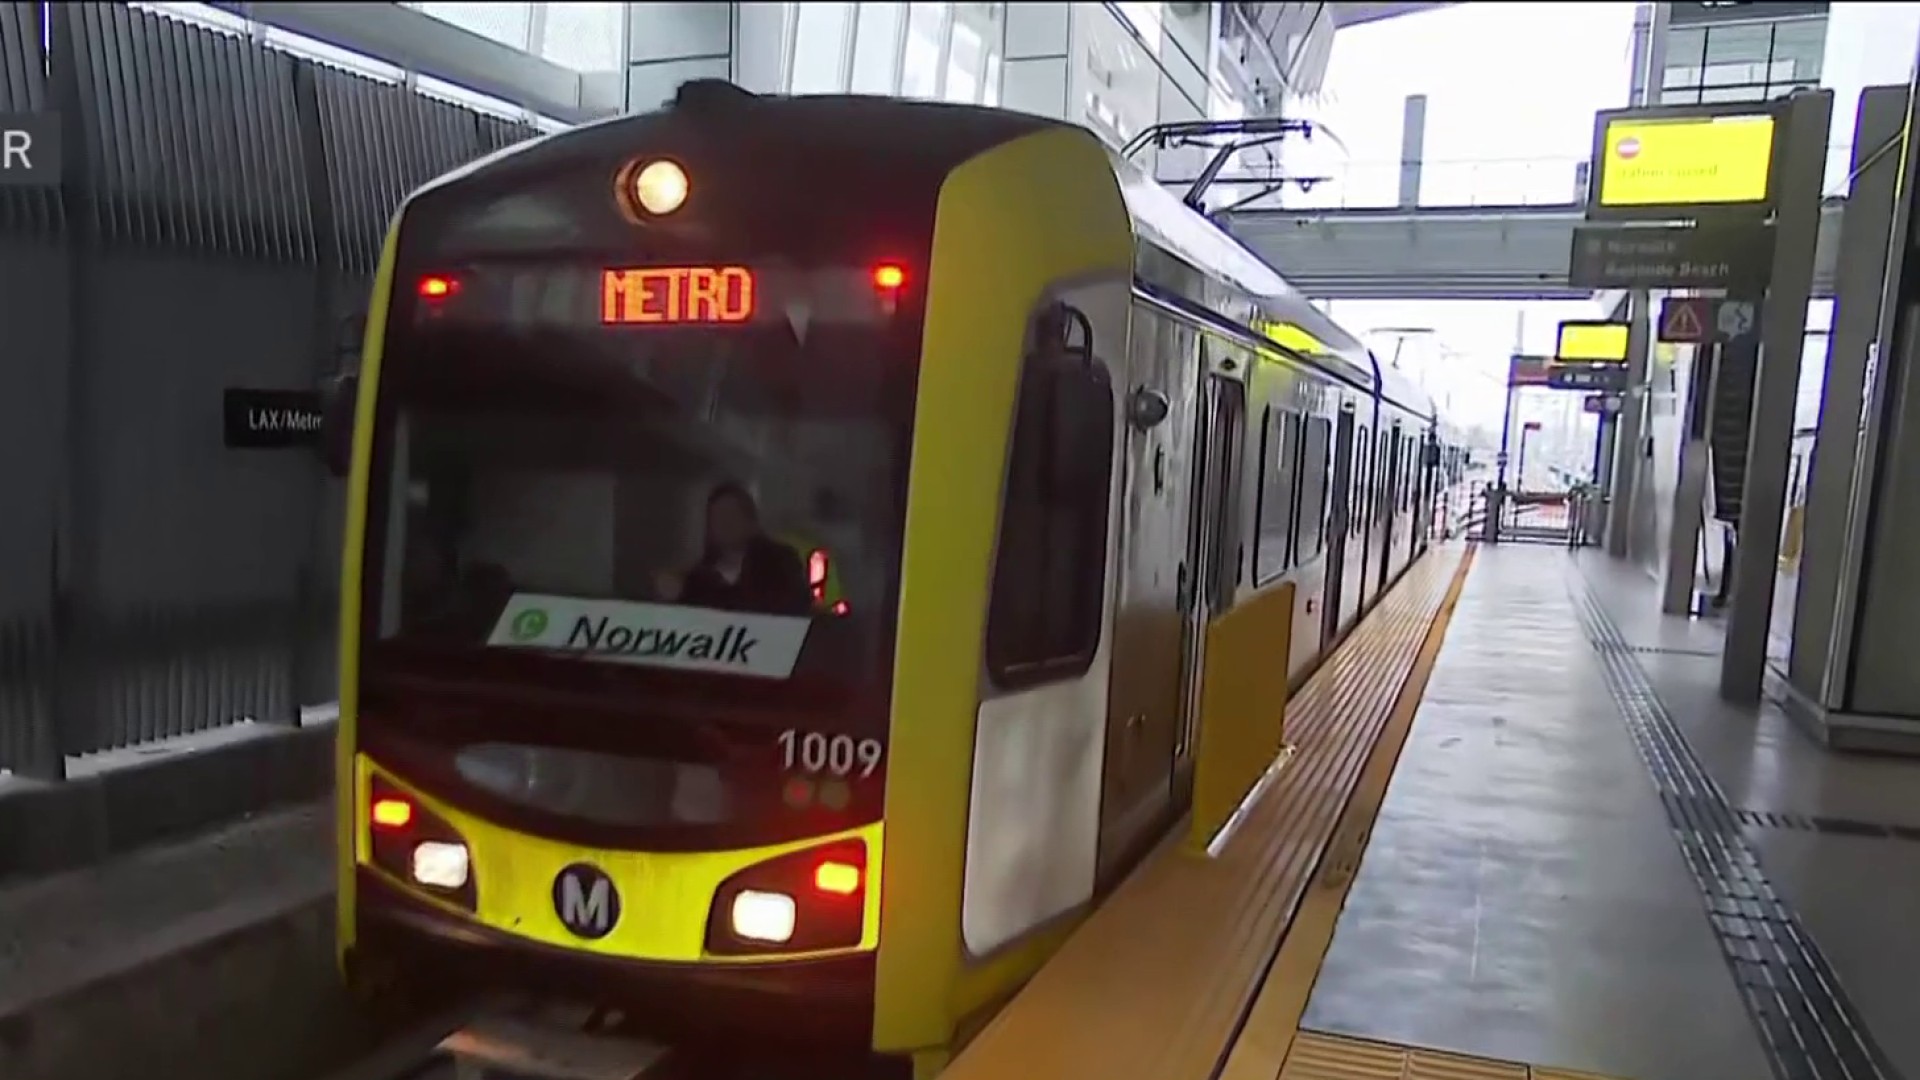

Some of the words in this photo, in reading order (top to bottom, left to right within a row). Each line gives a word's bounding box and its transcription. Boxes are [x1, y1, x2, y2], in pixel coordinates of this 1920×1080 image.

[604, 266, 752, 322] METRO
[567, 614, 758, 663] Norwalk
[778, 728, 882, 779] 1009
[562, 873, 609, 931] M
